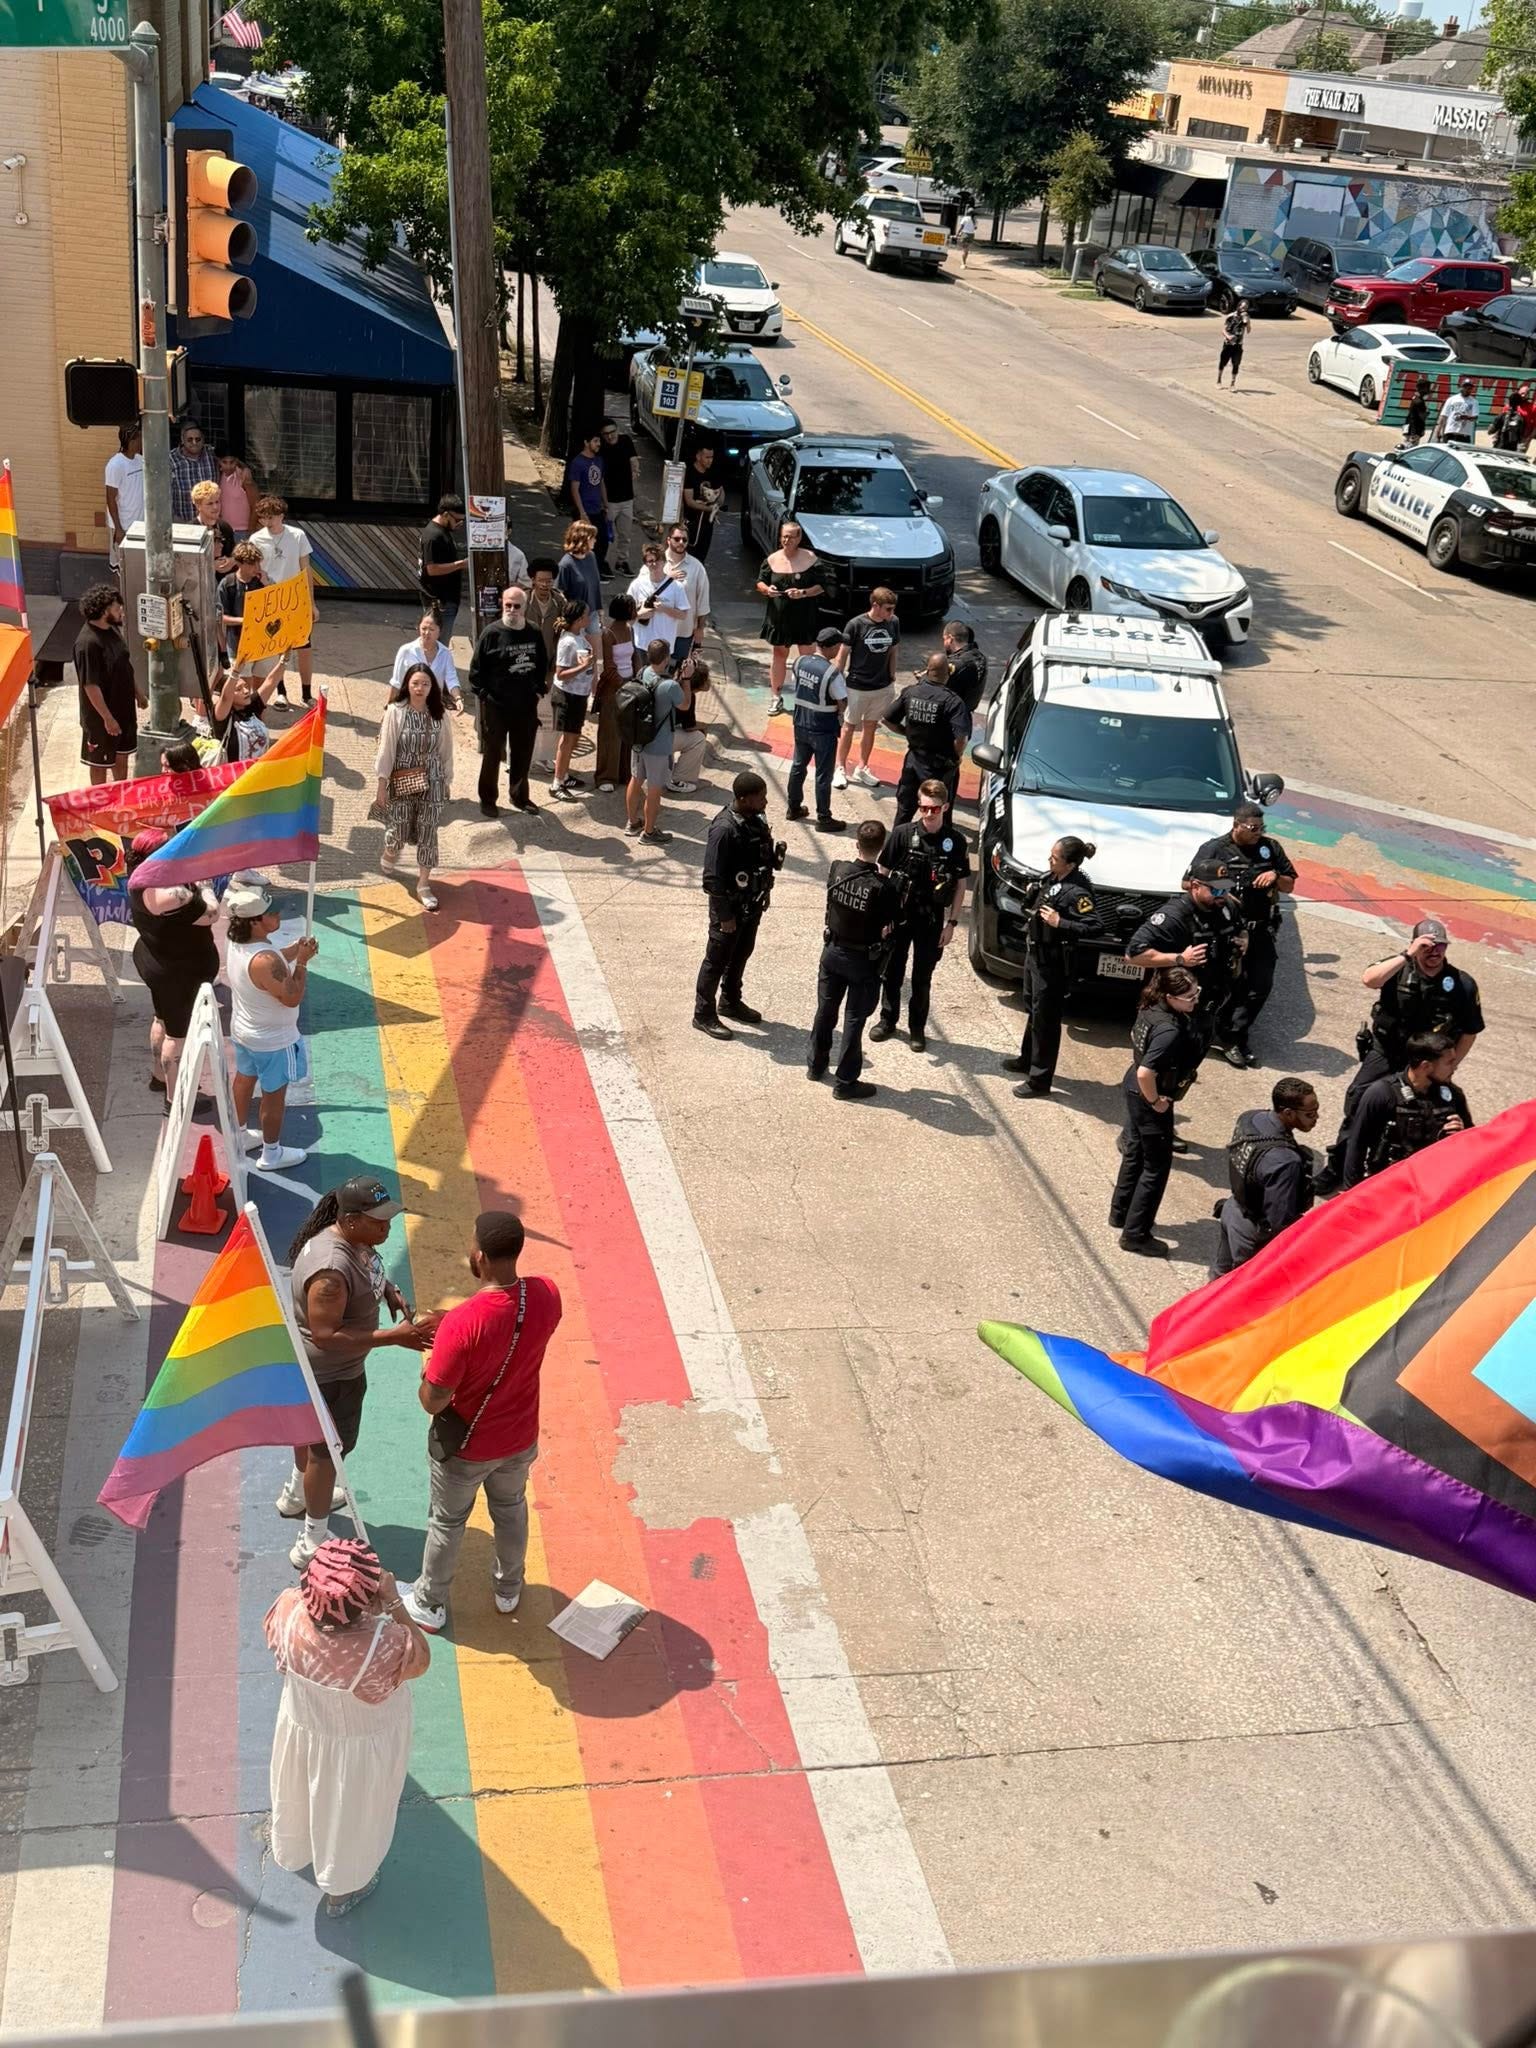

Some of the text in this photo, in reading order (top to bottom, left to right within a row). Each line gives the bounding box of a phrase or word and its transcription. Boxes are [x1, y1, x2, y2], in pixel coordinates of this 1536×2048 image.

[91, 16, 125, 42] 4000
[1304, 88, 1359, 113] THE NAIL SPA
[665, 384, 676, 393] 23
[662, 396, 676, 406] 103
[1380, 482, 1435, 520] POLICE
[254, 582, 300, 624] JESUS
[259, 636, 289, 655] YOU
[909, 698, 939, 713] DALLAS
[909, 710, 938, 724] POLICE
[832, 888, 867, 911] POLICE
